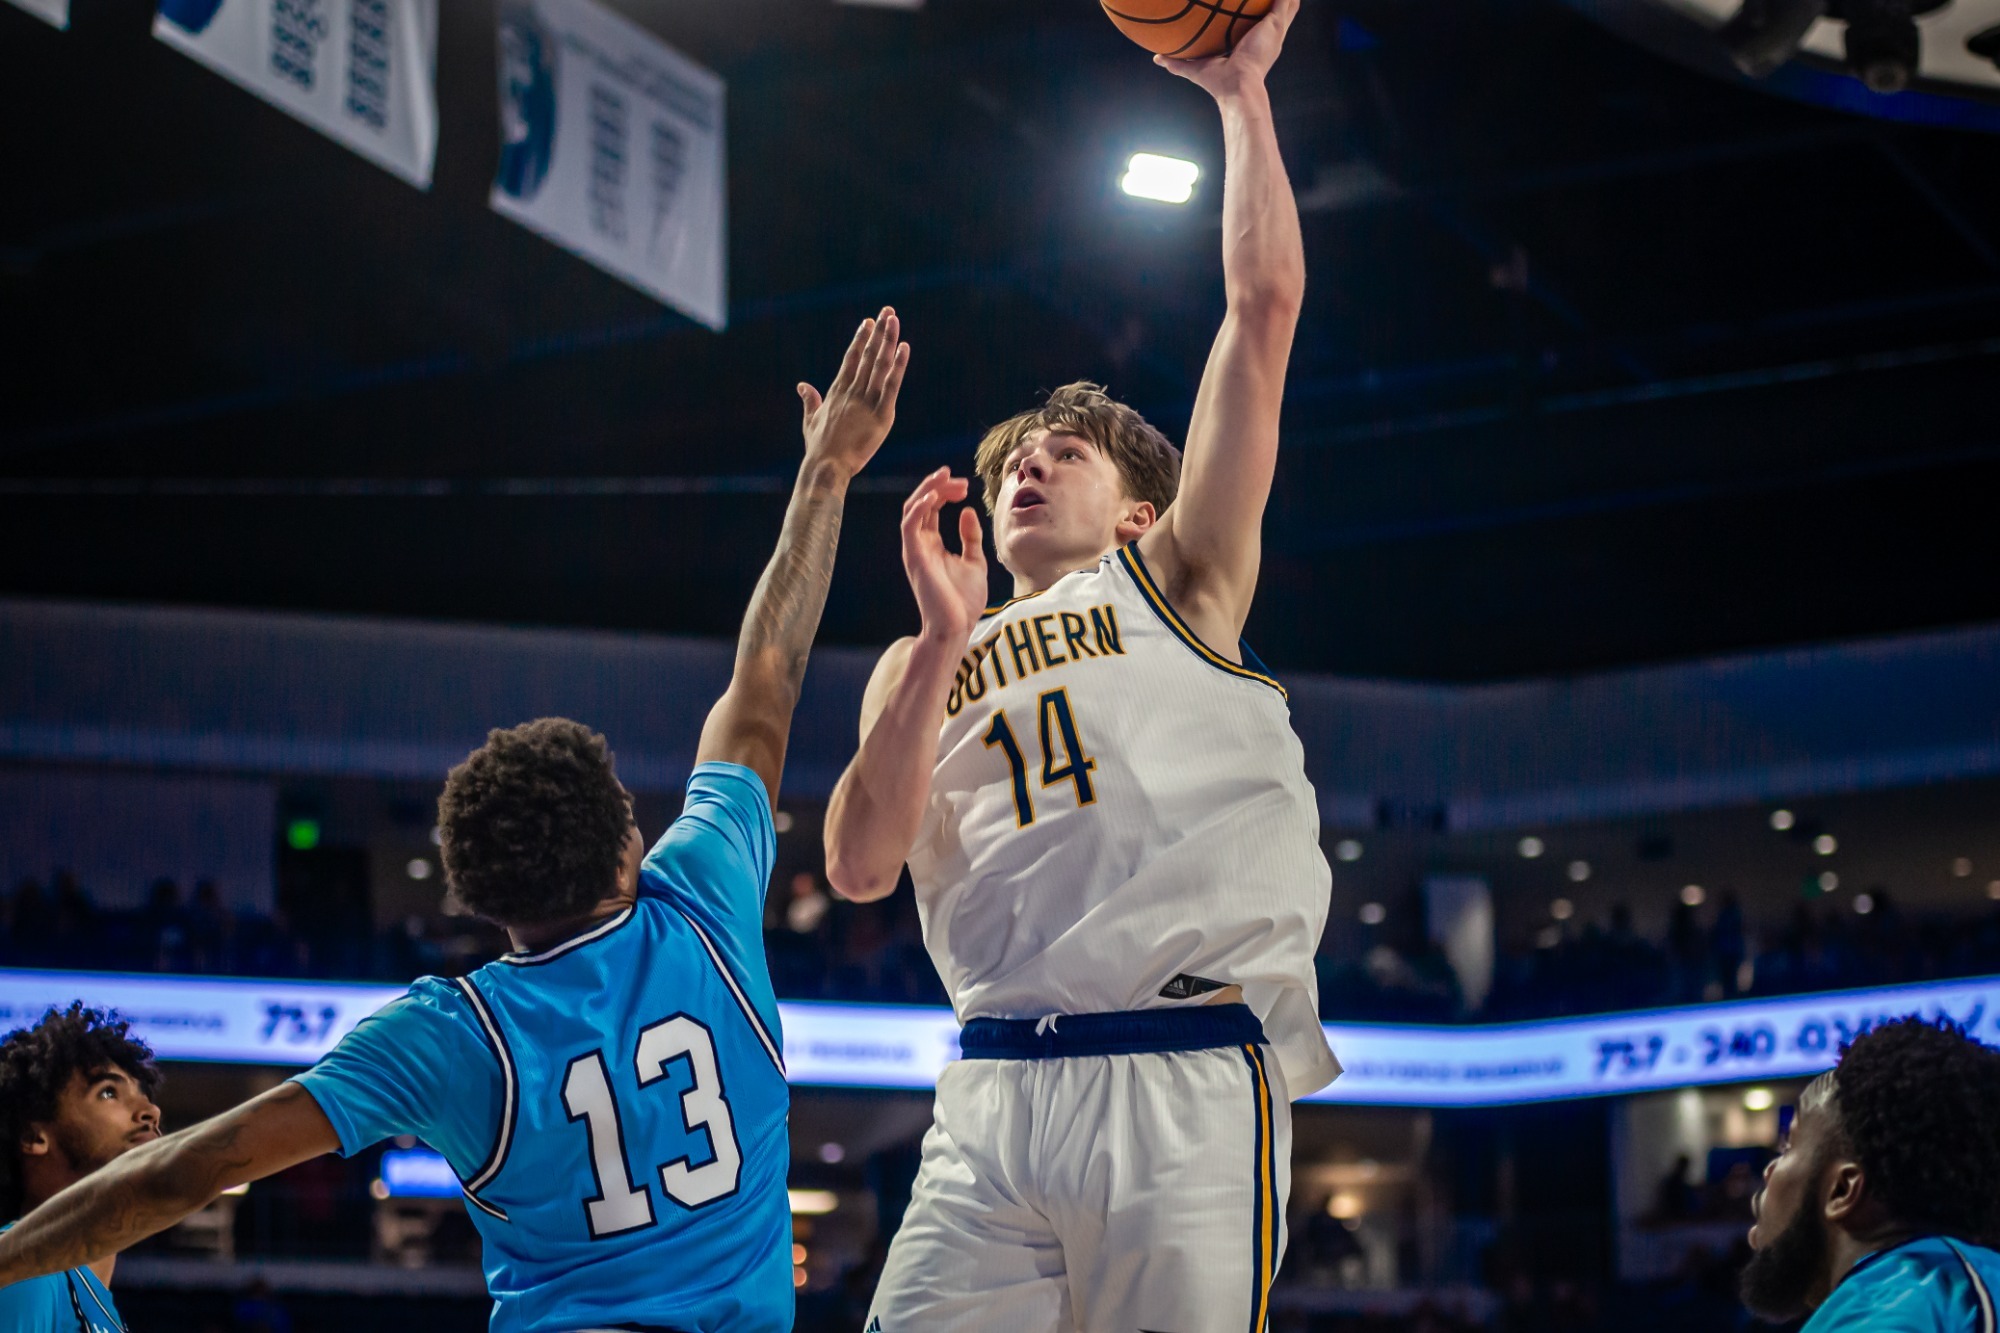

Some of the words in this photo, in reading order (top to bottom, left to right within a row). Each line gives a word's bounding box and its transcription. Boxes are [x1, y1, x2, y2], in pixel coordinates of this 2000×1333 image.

[942, 603, 1127, 722] OUTHERN
[980, 685, 1098, 829] 14
[560, 1010, 743, 1241] 13
